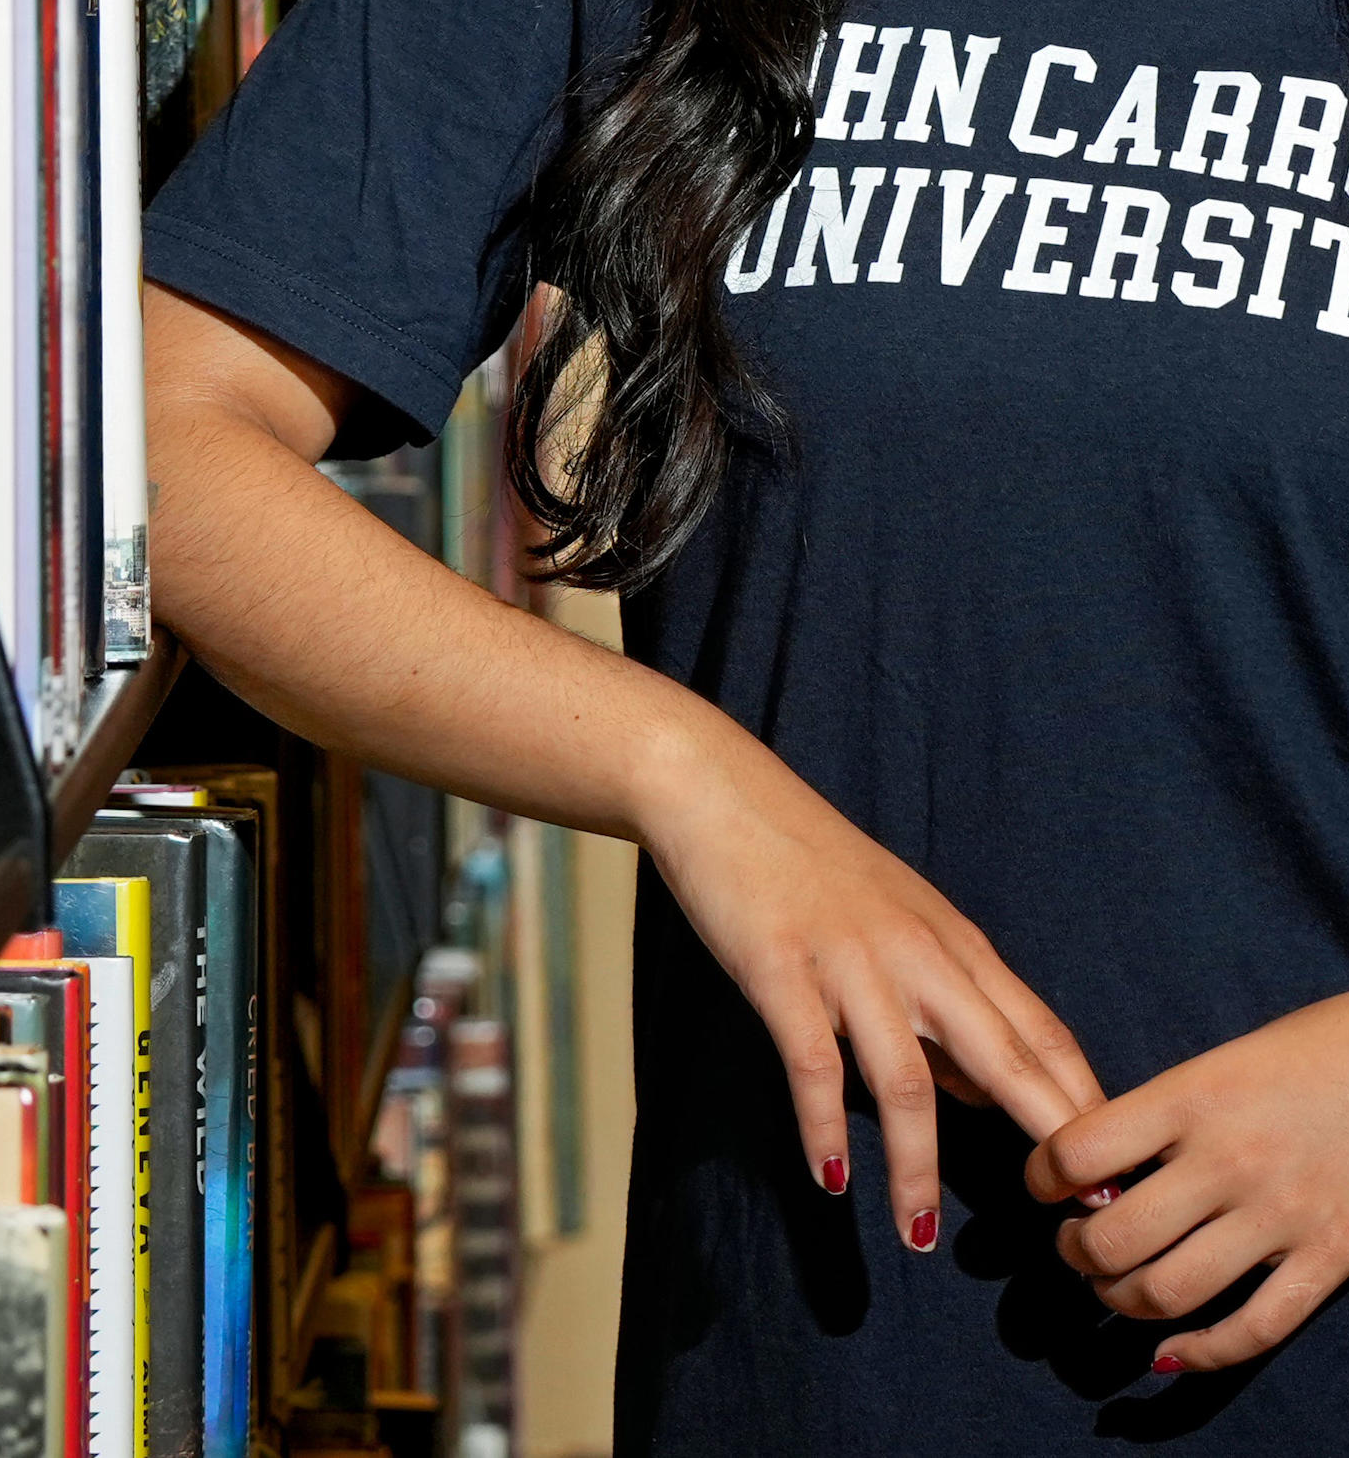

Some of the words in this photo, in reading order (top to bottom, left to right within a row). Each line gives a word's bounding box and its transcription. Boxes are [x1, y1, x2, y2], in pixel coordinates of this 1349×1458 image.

[794, 21, 1001, 147] HN
[196, 917, 207, 1027] THE
[138, 1029, 151, 1255] GENEVA
